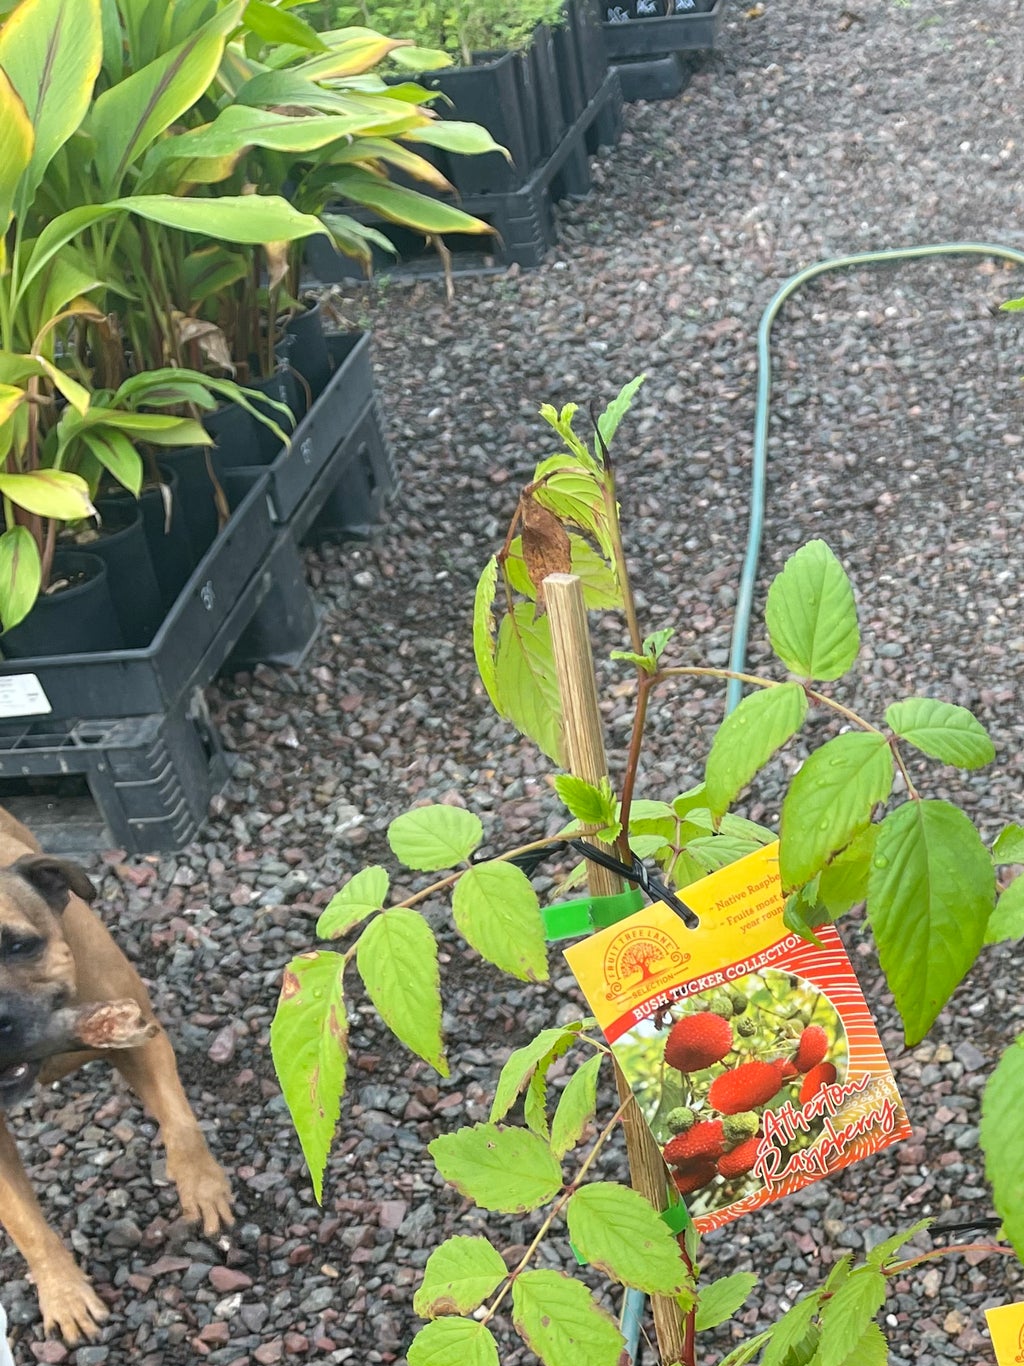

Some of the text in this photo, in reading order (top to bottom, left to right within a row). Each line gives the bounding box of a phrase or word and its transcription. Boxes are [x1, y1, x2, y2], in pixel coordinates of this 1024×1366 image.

[715, 873, 780, 911] Native Raspbe
[726, 894, 778, 926] Fruits most
[740, 917, 760, 934] year
[607, 930, 674, 978] FRUIT TREE LANE
[632, 973, 674, 999] SELECTION
[632, 993, 671, 1020] BUSH
[669, 972, 725, 1000] TUCKER
[757, 1072, 871, 1155] Atherton
[754, 1098, 898, 1190] Raspberry
